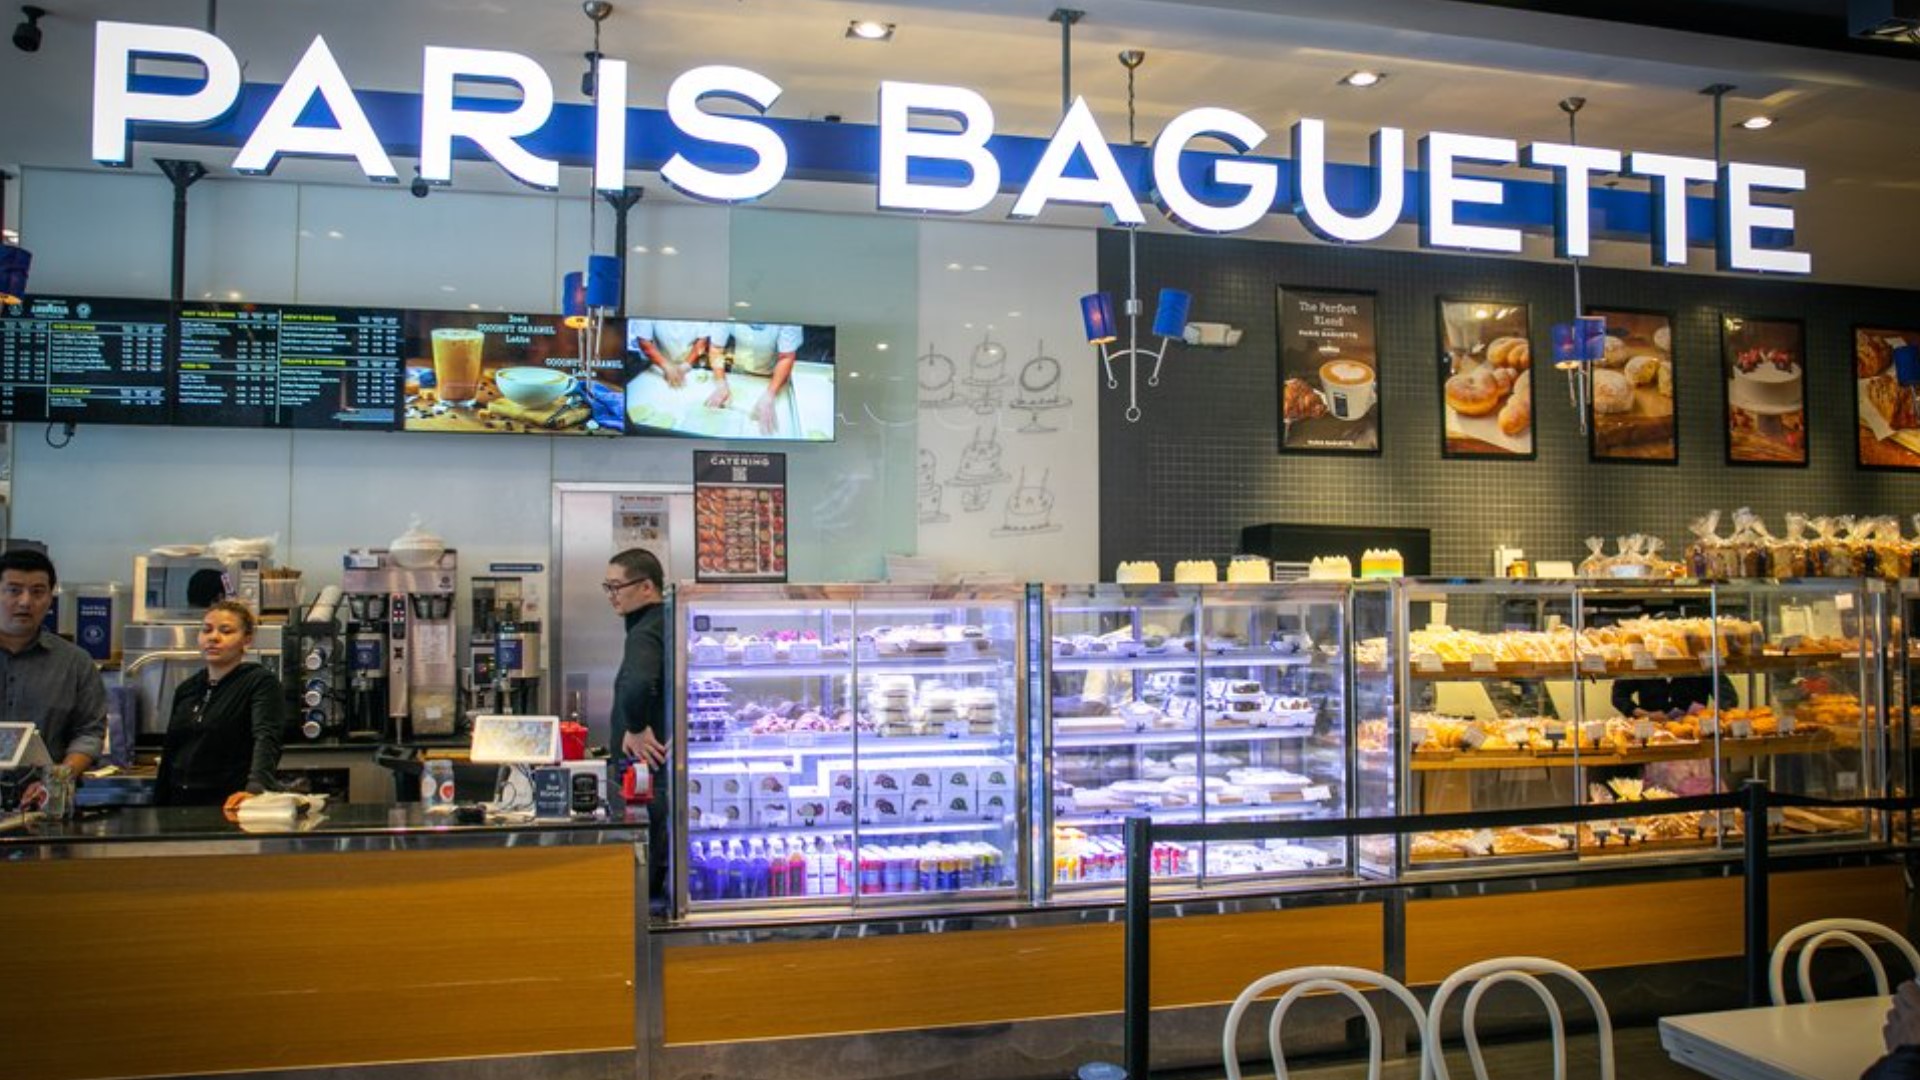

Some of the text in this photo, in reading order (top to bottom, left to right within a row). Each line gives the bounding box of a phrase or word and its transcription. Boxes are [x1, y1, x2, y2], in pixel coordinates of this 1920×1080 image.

[92, 21, 1811, 274] PARIS BAGUETTE
[1299, 301, 1358, 315] The Perfect
[1313, 315, 1344, 327] Blend
[710, 457, 770, 467] CATERING
